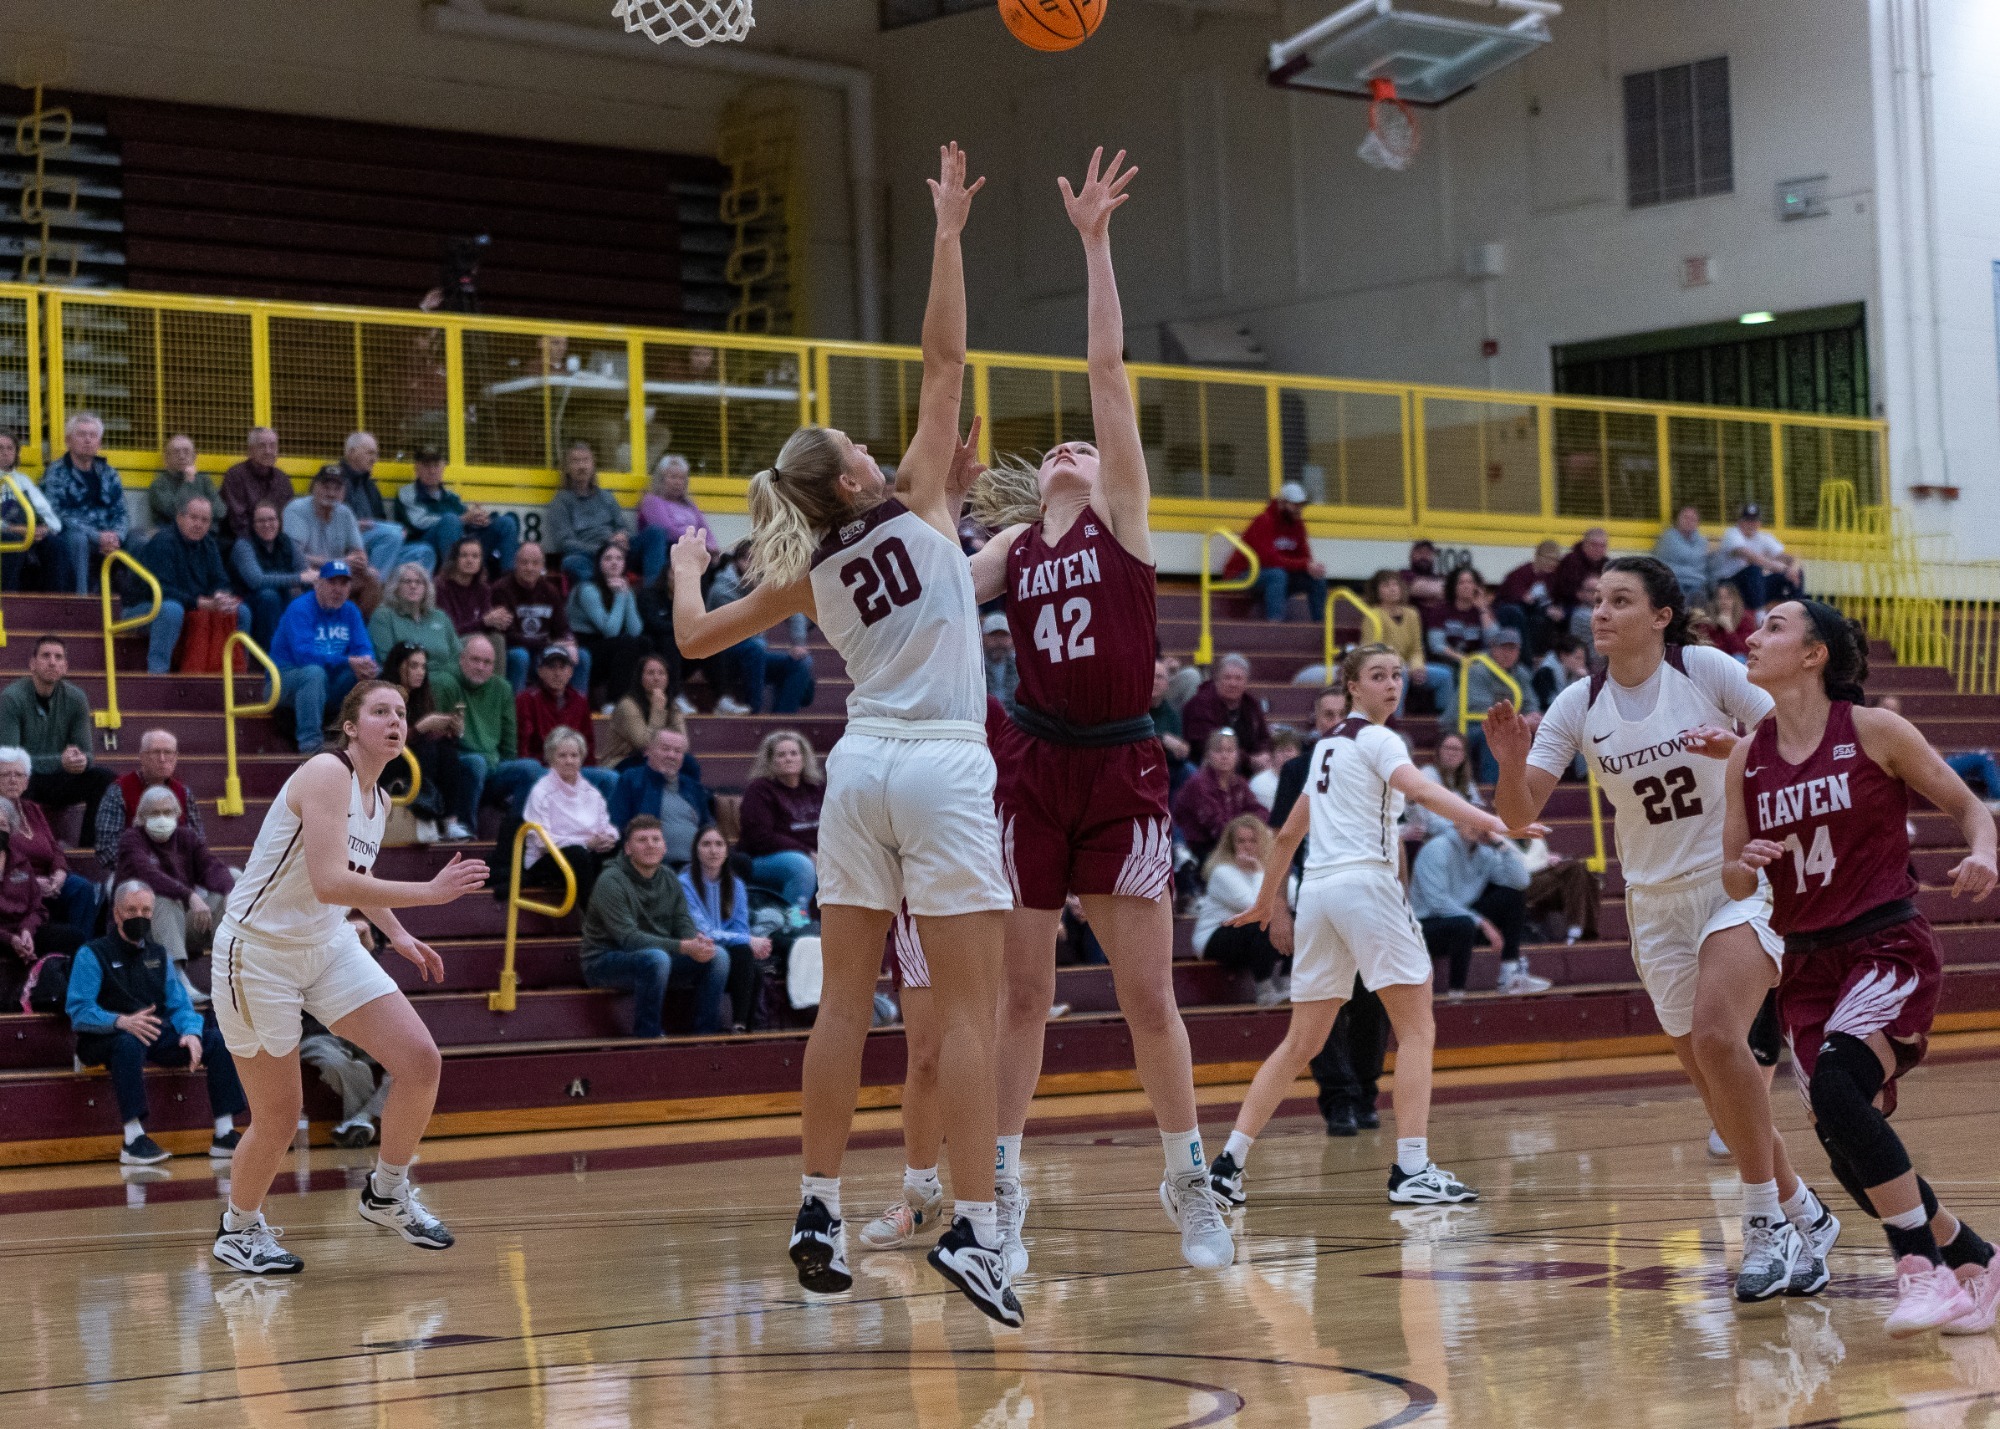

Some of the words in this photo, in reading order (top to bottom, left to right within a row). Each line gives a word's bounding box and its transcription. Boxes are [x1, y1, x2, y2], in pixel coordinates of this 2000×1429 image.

[839, 536, 923, 628] 20
[1018, 546, 1101, 602] HAVEN
[1033, 596, 1096, 664] 42
[1316, 748, 1335, 794] 5
[1597, 735, 1697, 775] KUTZTOW
[1834, 745, 1856, 758] PSAC
[1632, 766, 1704, 825] 22
[1757, 772, 1853, 832] HAVEN
[1784, 825, 1838, 895] 14
